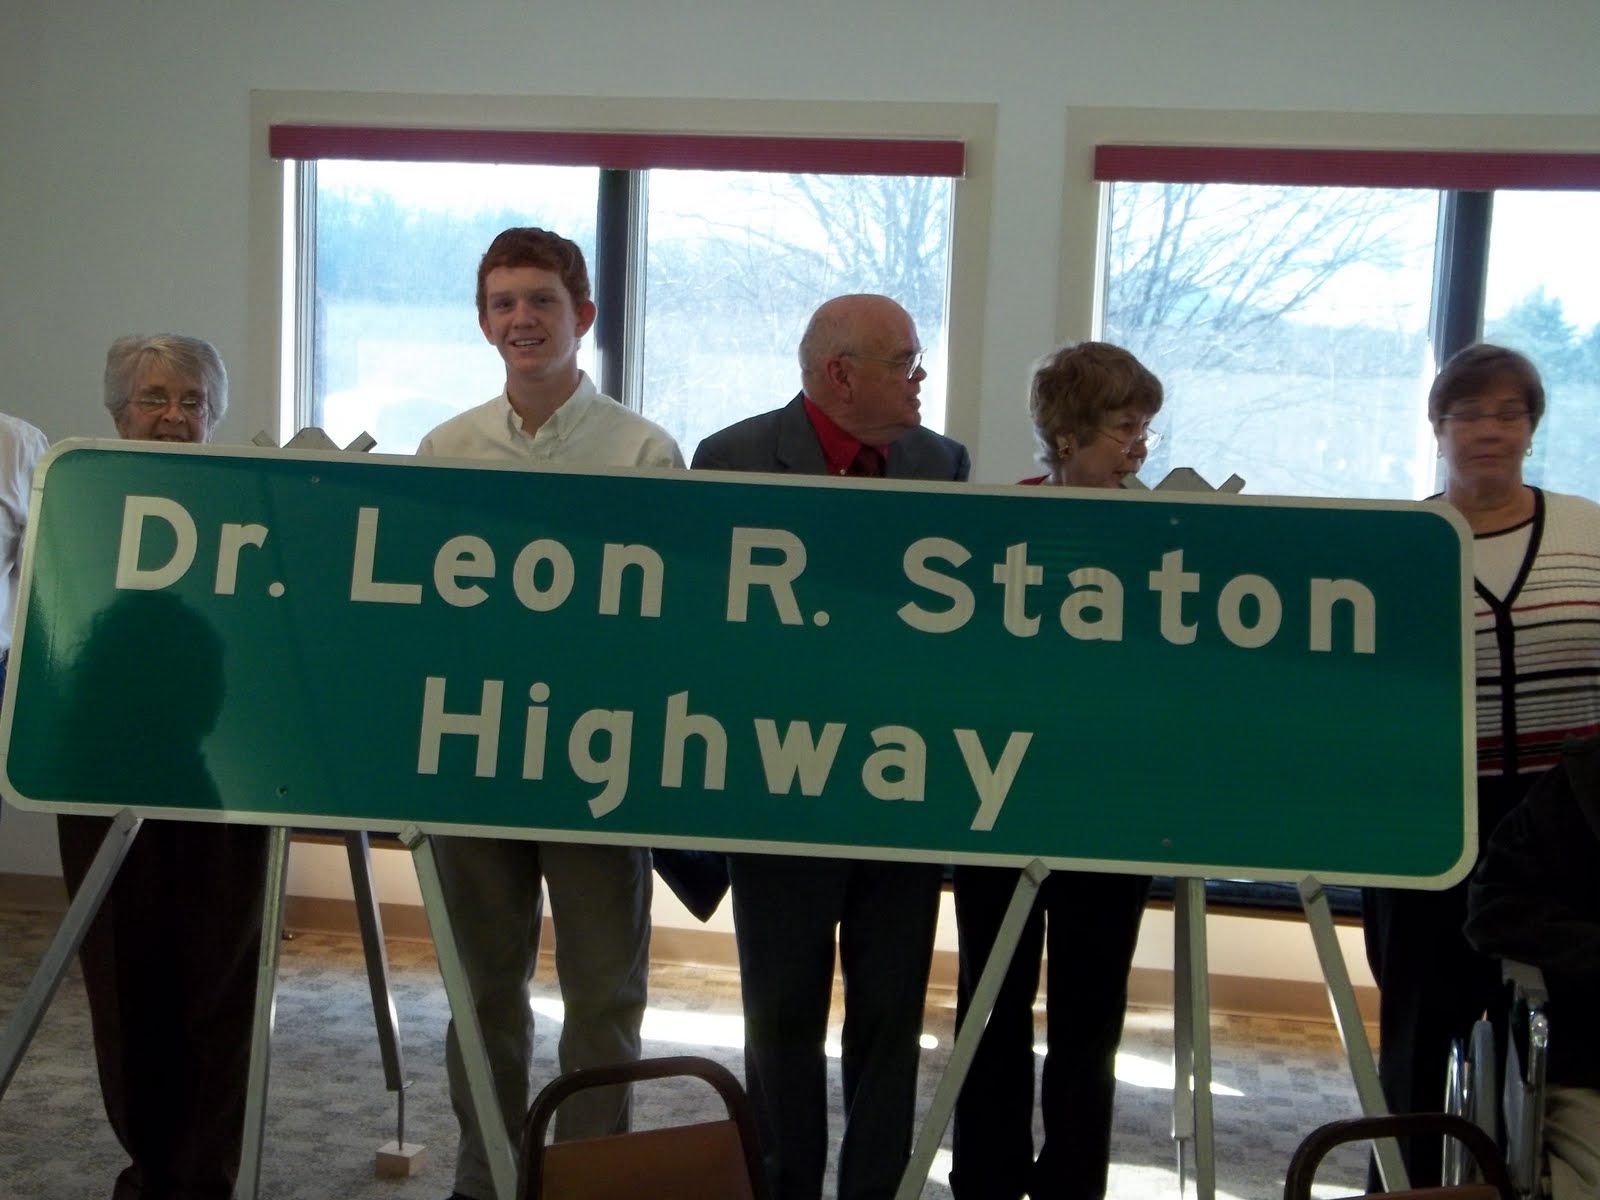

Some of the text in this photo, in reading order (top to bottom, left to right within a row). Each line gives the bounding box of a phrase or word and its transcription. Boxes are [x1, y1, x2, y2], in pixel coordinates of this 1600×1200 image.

[115, 495, 1377, 654] Dr. Leon R. Staton
[417, 677, 1034, 832] Highway
